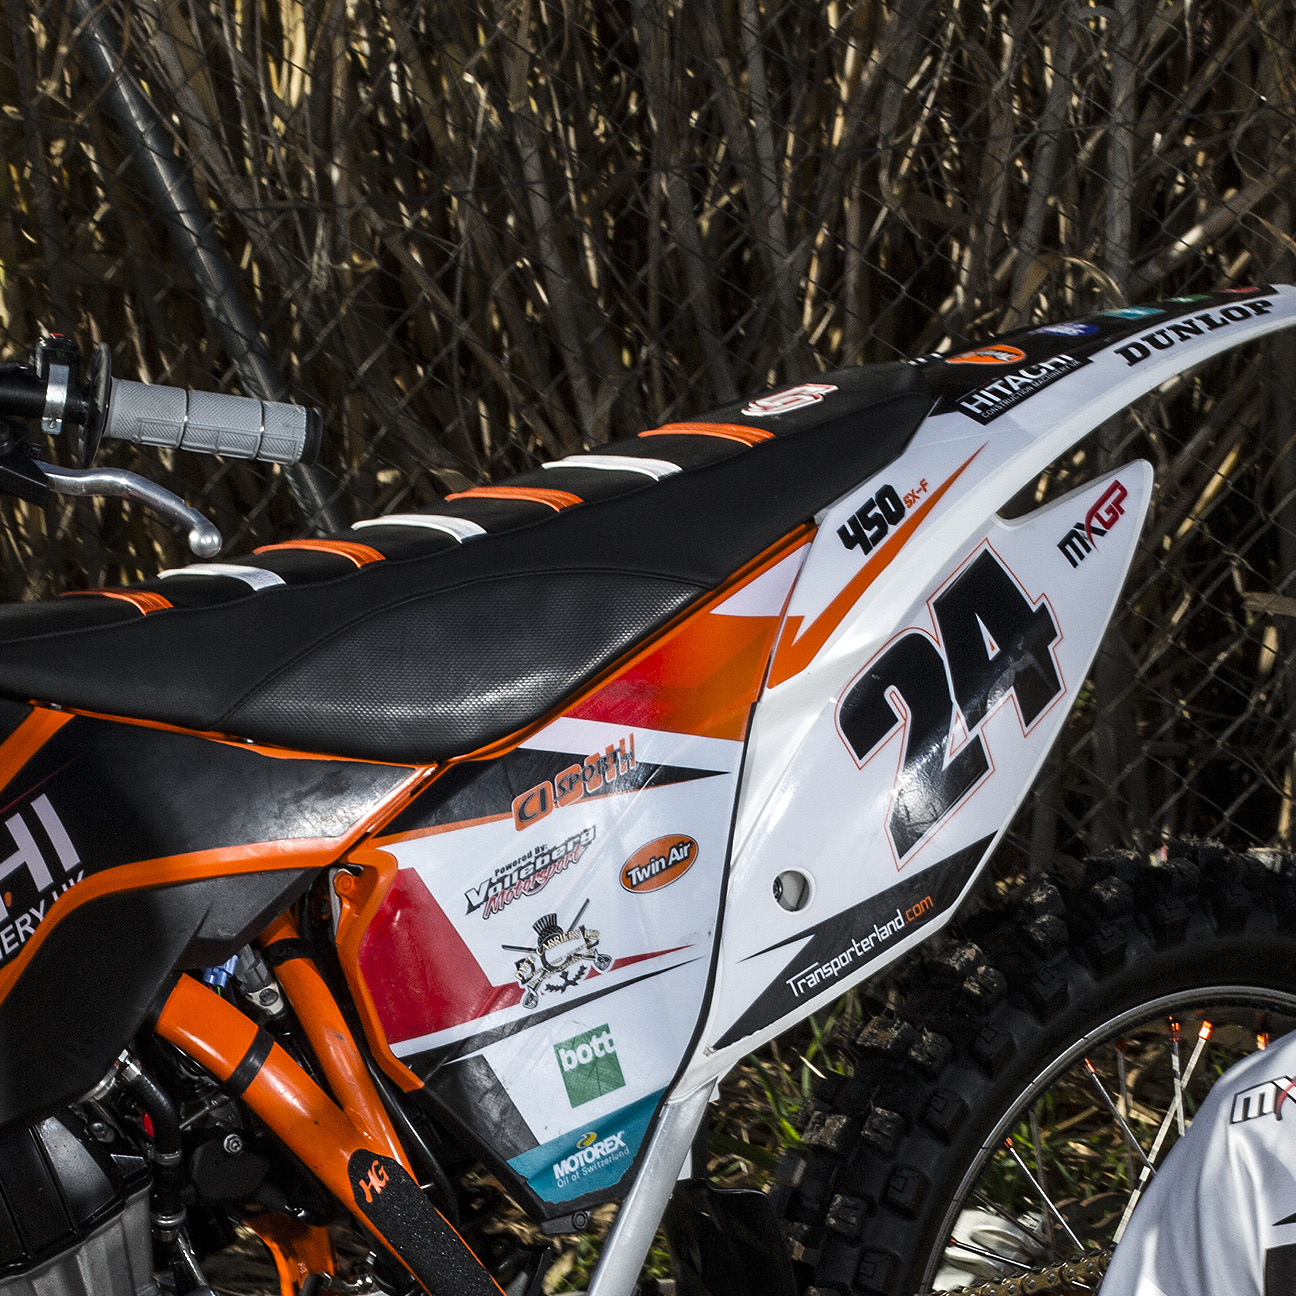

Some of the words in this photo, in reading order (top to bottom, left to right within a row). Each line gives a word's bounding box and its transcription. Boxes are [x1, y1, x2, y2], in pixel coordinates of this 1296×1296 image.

[1113, 299, 1274, 367] DUNLOP
[960, 354, 1078, 414] HITACHI
[836, 484, 906, 556] 450
[1056, 479, 1129, 568] MXGP
[840, 547, 1059, 860] 24
[517, 790, 549, 823] CI
[483, 845, 589, 919] Motorsport
[494, 850, 532, 877] Powered
[628, 855, 666, 886] Twin
[665, 841, 692, 867] Air
[536, 929, 581, 957] CARRIERS
[786, 895, 934, 998] Transporterland.com
[559, 1031, 616, 1072] bott
[553, 1131, 626, 1180] MOTOREX
[556, 1176, 569, 1188] Oil
[572, 1171, 580, 1182] of
[582, 1148, 630, 1177] Switzerland
[360, 1159, 390, 1203] HG
